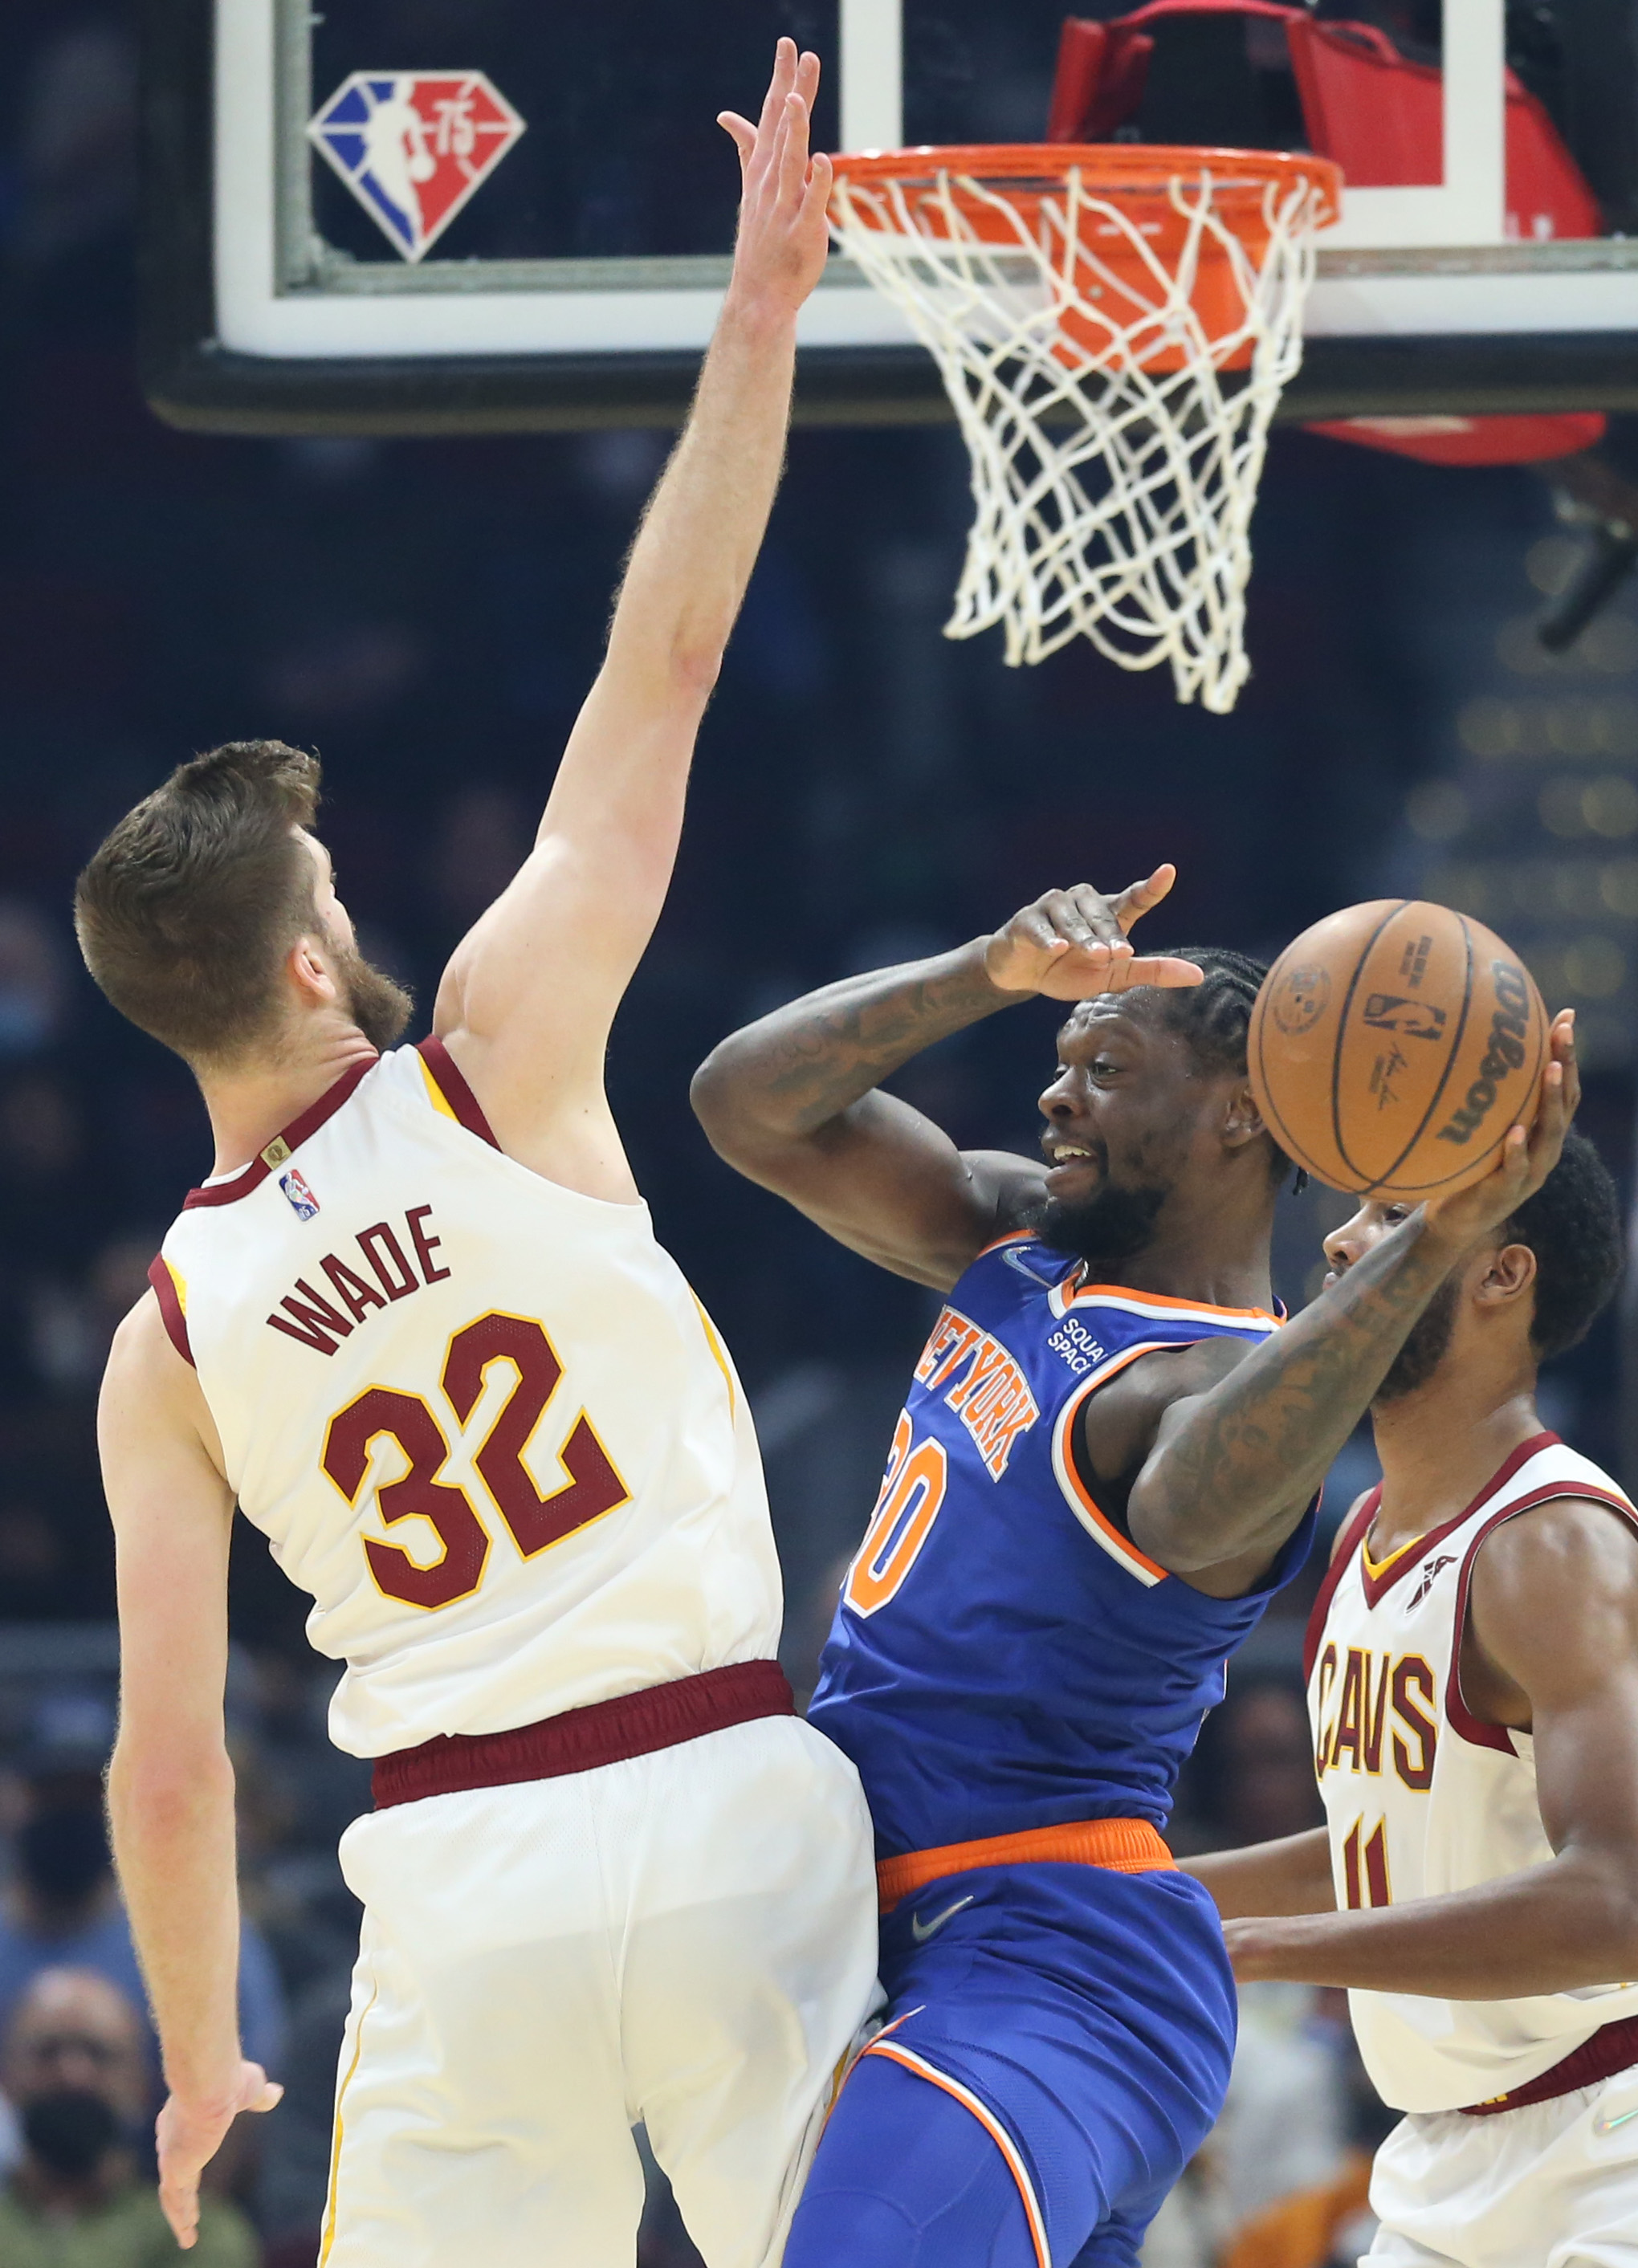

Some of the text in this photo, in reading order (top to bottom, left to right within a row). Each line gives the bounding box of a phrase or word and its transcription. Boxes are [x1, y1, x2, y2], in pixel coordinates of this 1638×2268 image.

[267, 1204, 451, 1356] WADE
[1062, 1318, 1108, 1363] SQUA
[319, 1309, 634, 1612] 32
[943, 1333, 1041, 1484] YORK
[1316, 1640, 1439, 1794] CAVS
[1343, 1811, 1392, 1910] 11
